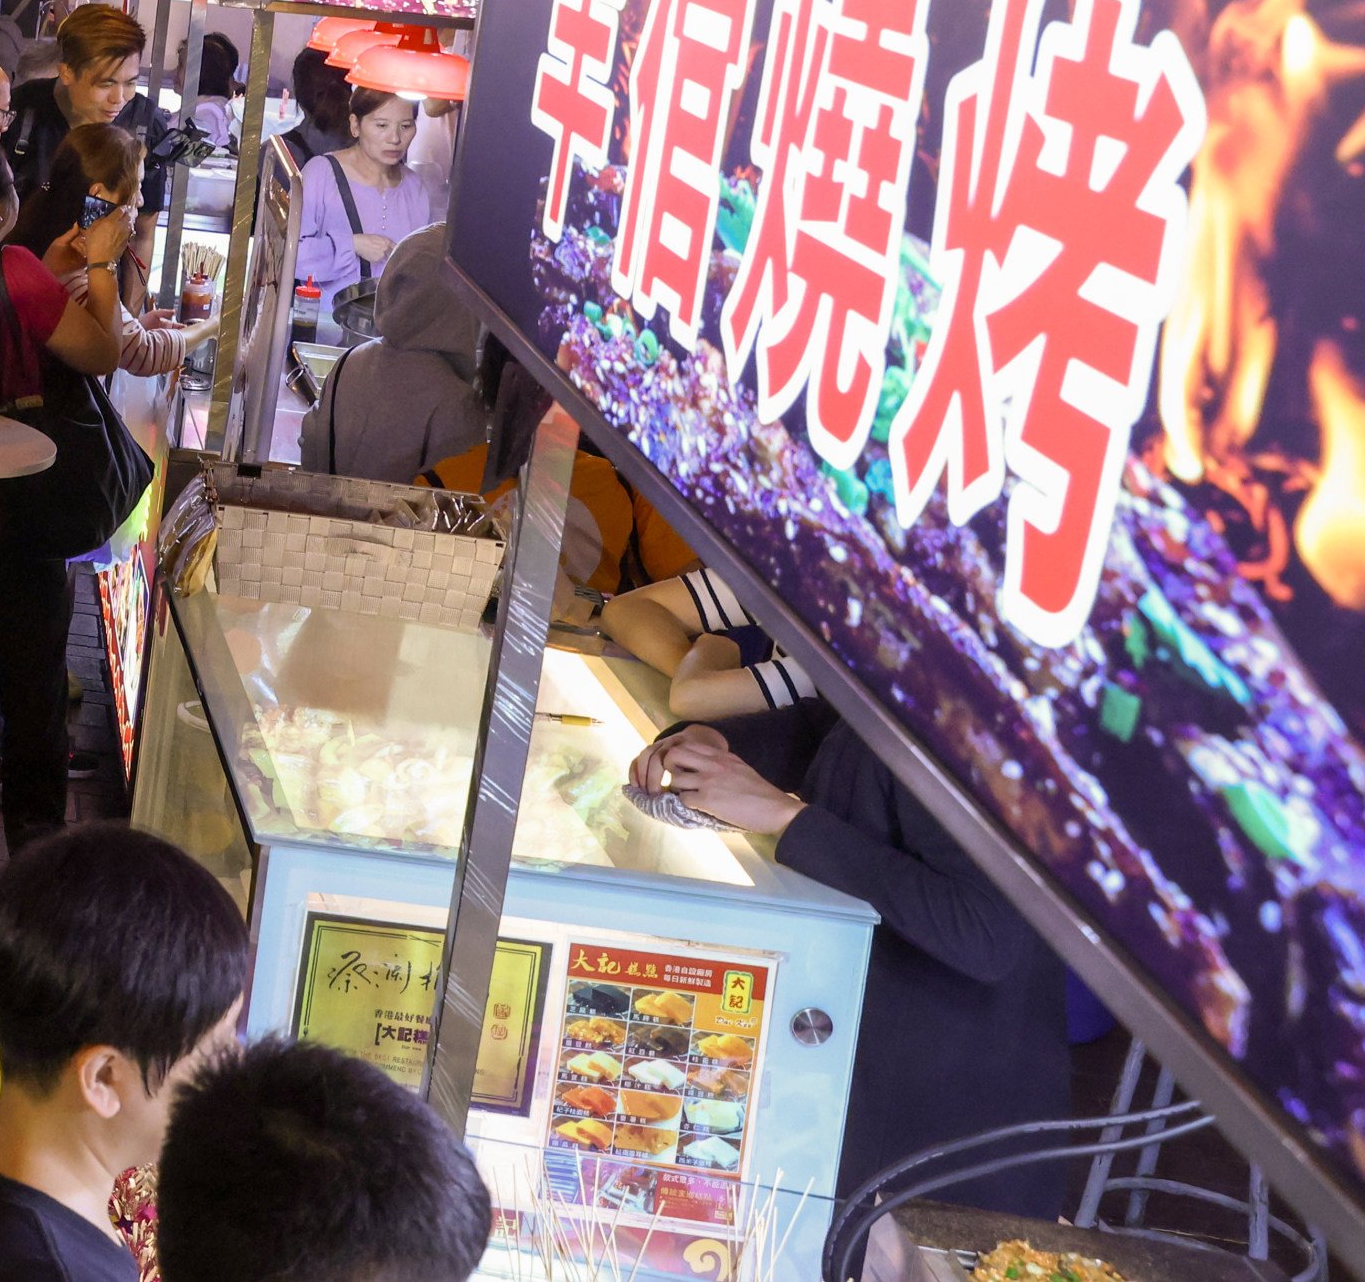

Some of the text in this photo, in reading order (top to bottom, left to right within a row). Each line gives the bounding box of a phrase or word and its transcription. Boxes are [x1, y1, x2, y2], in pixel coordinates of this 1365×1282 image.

[571, 948, 659, 980] 大記糕點
[728, 976, 746, 1010] 大記
